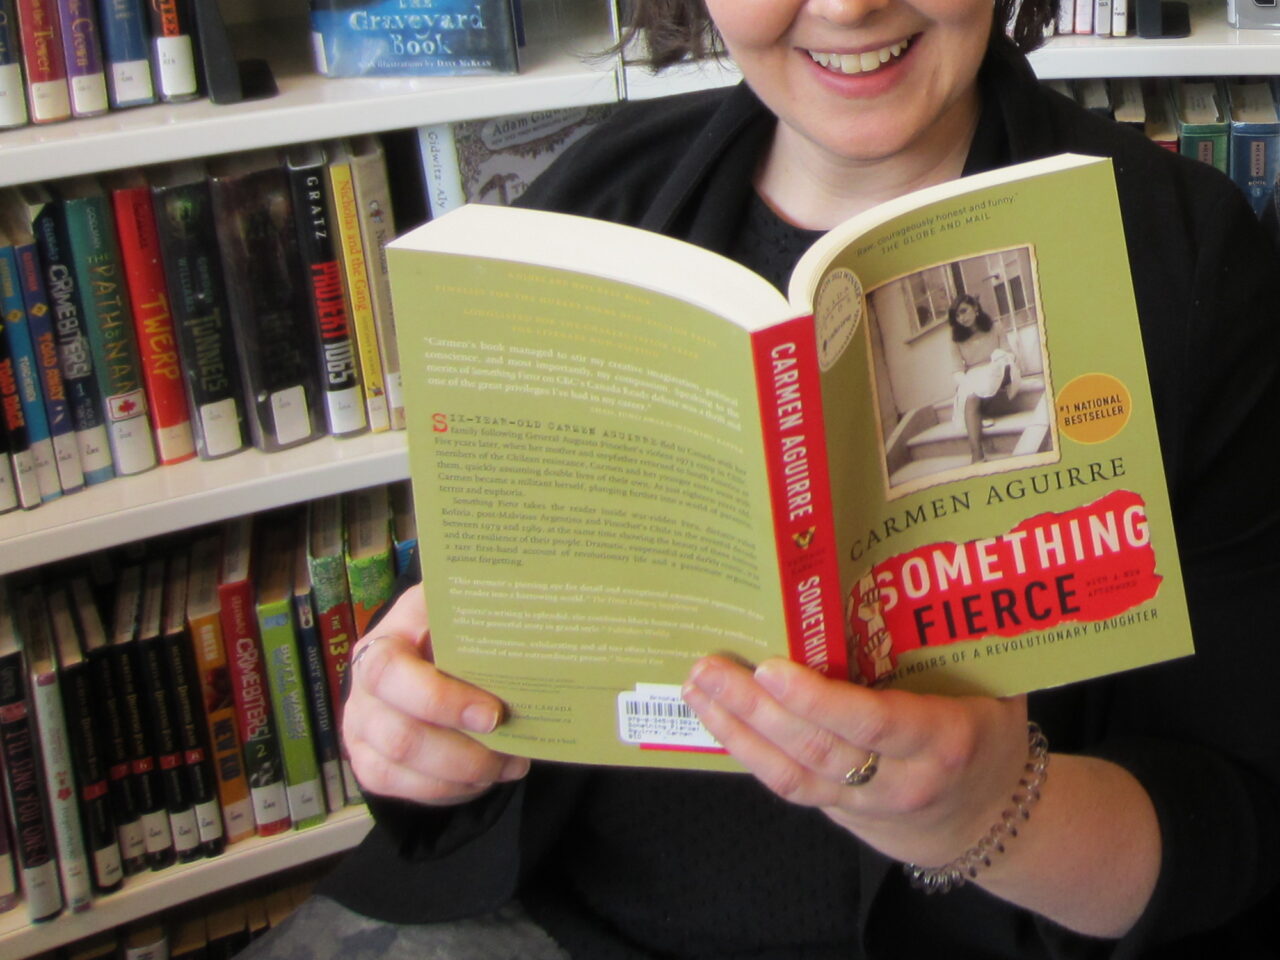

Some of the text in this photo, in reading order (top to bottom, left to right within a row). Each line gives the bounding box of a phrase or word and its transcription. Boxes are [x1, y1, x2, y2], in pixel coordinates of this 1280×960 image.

[72, 16, 94, 67] Crown
[350, 5, 486, 40] Graveyard
[391, 34, 453, 56] Book
[427, 131, 443, 182] Gidwitz
[306, 176, 327, 240] GRATZ
[881, 213, 991, 255] THE GLOBE AND MAIL
[936, 200, 986, 221] honest and
[339, 178, 368, 312] Nicholas and the Gang
[92, 265, 124, 329] PATH
[176, 256, 195, 313] WILLIAMS
[40, 332, 55, 367] TOAD
[140, 292, 180, 380] TWERP
[183, 307, 228, 393] TUNNELS
[323, 340, 359, 385] 1065
[771, 341, 804, 432] CARMEN
[1074, 394, 1122, 413] NATIONAL
[1064, 404, 1124, 427] BESTSELLER
[780, 433, 814, 522] AGUIRRE
[848, 490, 972, 562] CARMEN
[985, 456, 1126, 506] AGUIRRE
[877, 503, 1152, 613] SOMETHING
[913, 572, 1081, 647] FIERCE
[887, 608, 1159, 682] MEMOIRS OF A REVOLUTIONARY DAUGHTER
[235, 637, 271, 759] CRIMEBITERS! 2
[287, 690, 308, 739] WARS!
[306, 645, 331, 736] JUST STUPID!
[10, 760, 36, 792] SING
[18, 792, 41, 820] YOU
